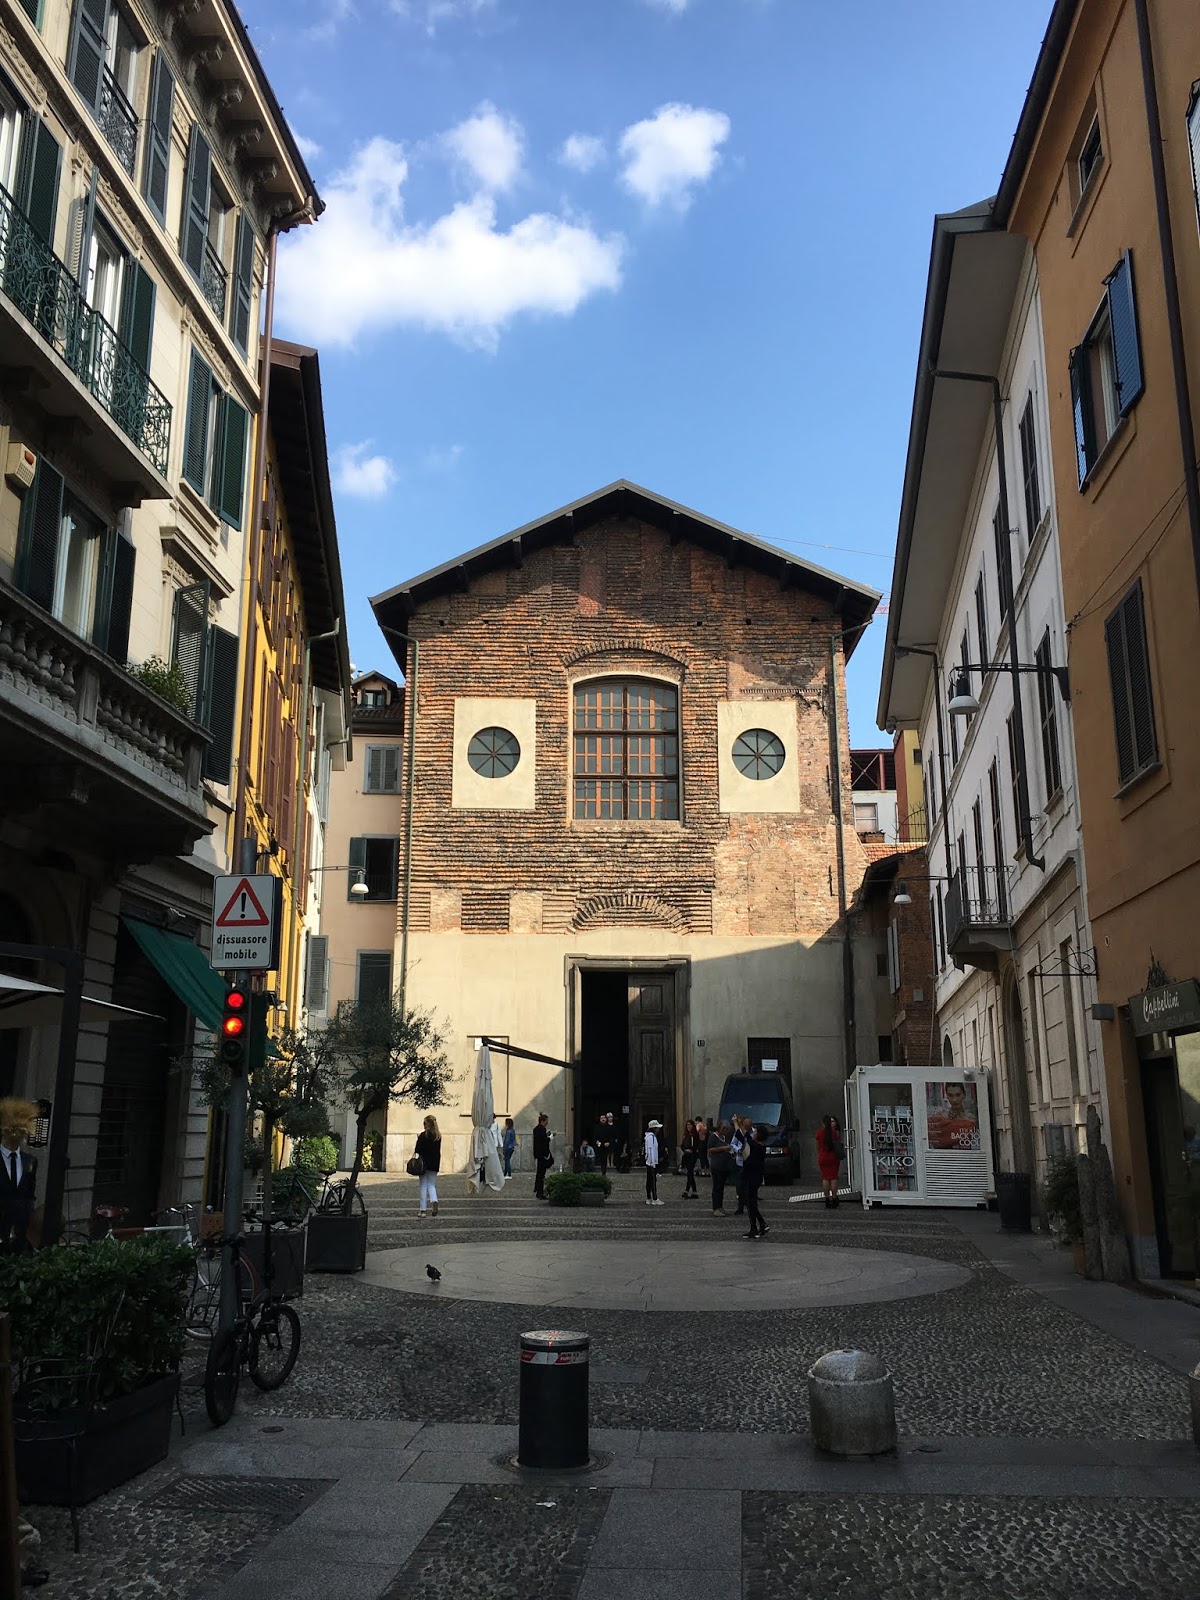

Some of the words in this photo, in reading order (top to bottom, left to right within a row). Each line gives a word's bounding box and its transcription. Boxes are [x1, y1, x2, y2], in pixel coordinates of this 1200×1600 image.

[216, 934, 267, 944] dissuasore
[224, 949, 257, 959] mobile
[1143, 990, 1180, 1023] Cappellini
[874, 1123, 913, 1134] BEAUTY
[950, 1132, 970, 1140] BACK
[876, 1156, 914, 1167] KIKO
